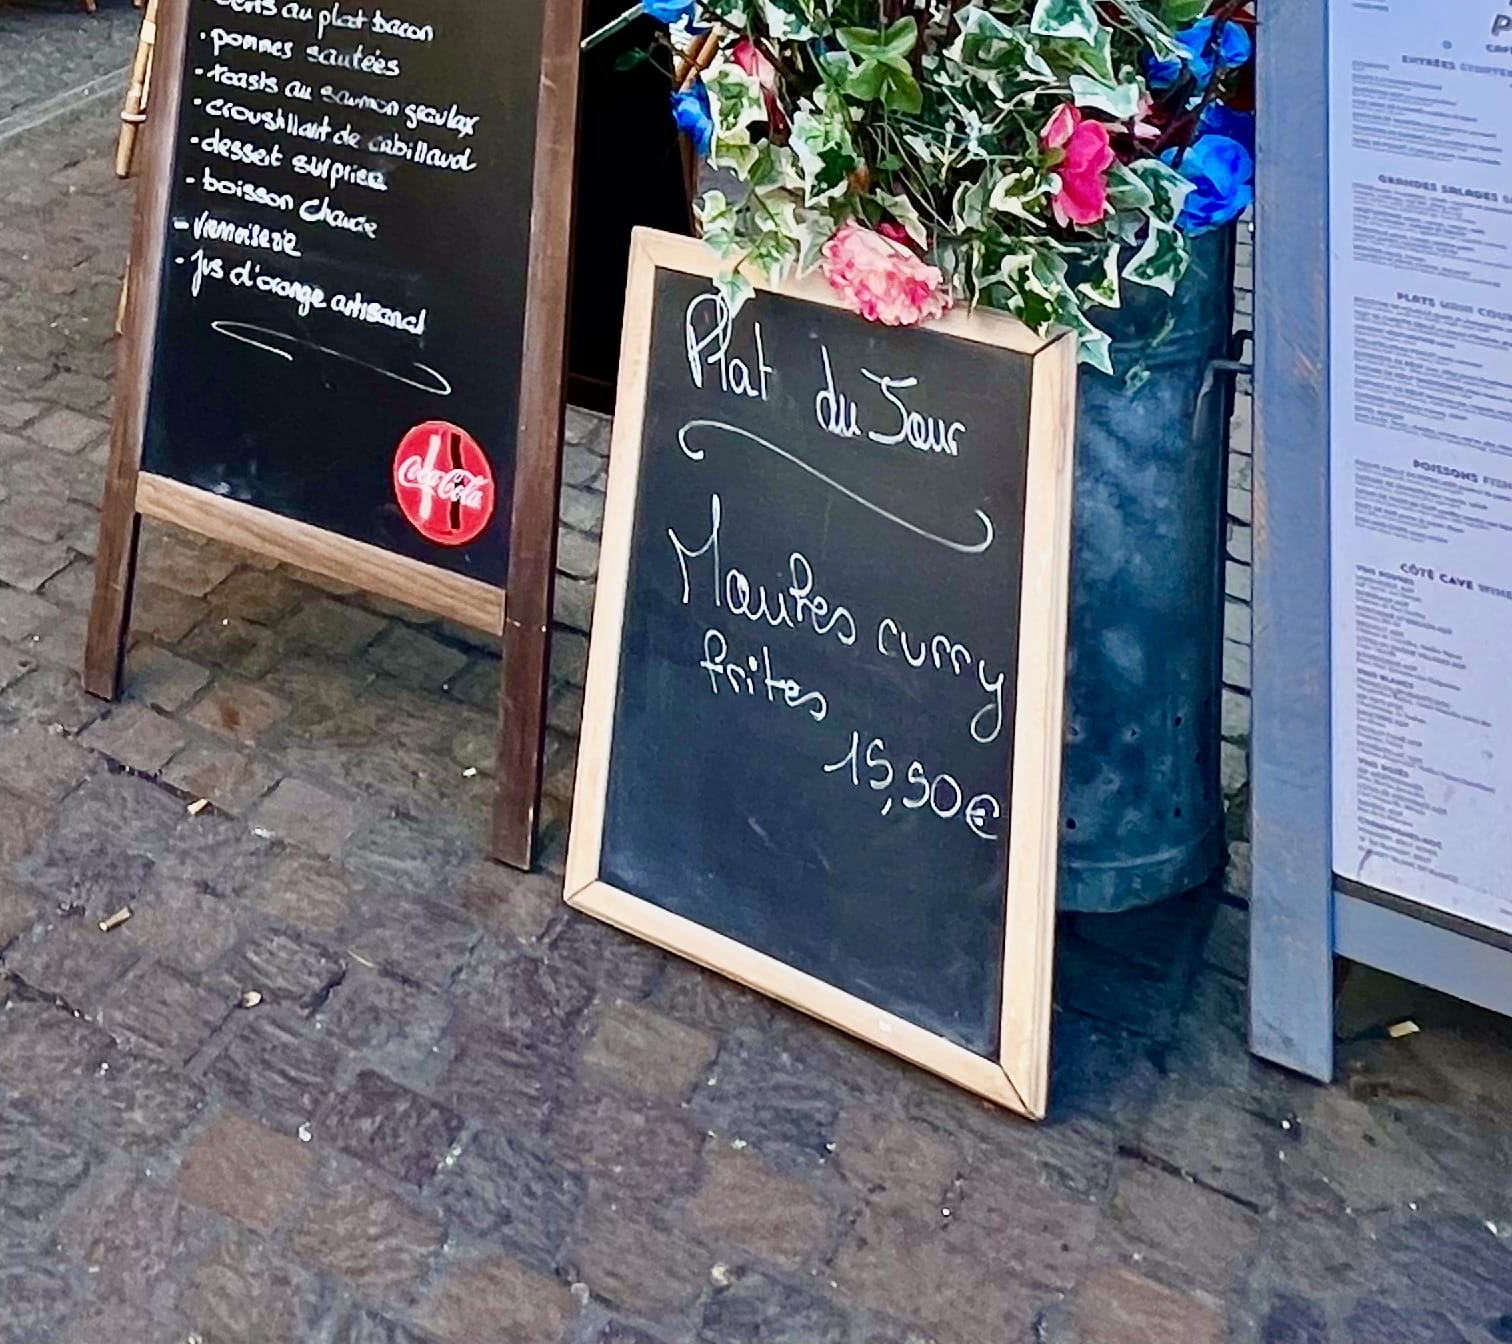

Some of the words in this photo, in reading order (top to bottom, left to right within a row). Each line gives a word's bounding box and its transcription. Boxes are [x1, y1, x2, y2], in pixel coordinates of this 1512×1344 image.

[318, 1, 368, 40] plat
[371, 10, 434, 42] bacon
[206, 63, 279, 94] toasts
[284, 80, 313, 102] au
[332, 123, 360, 148] de
[202, 166, 294, 211] boisson
[686, 293, 772, 403] Plat
[700, 628, 827, 721] frites
[878, 617, 1005, 744] curry
